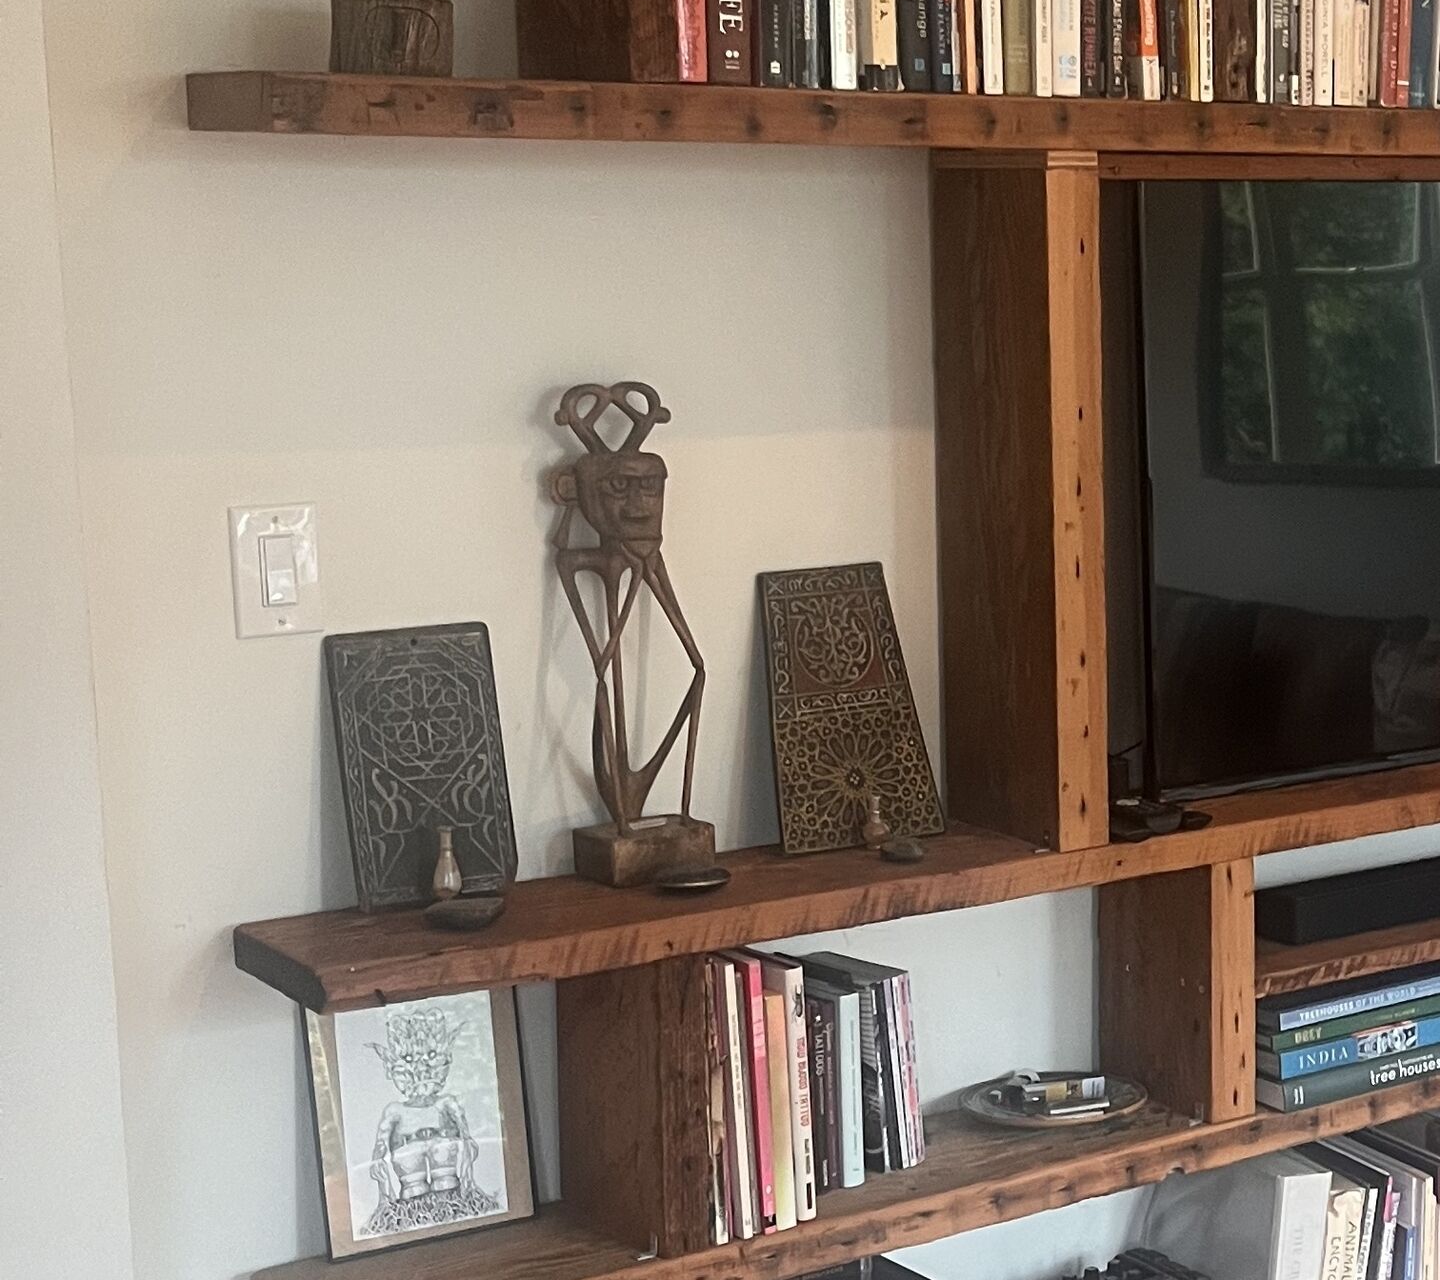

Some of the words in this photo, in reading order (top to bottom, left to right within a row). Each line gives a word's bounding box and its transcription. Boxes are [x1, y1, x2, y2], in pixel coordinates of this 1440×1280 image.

[1085, 26, 1097, 76] RUNNER
[1321, 32, 1329, 78] MORELL
[1299, 1000, 1355, 1022] TREEHOUSES
[1355, 997, 1367, 1008] OF
[1368, 993, 1386, 1005] THE
[1386, 987, 1417, 1002] WORLD
[1299, 1046, 1350, 1070] INDIA
[1370, 1067, 1397, 1086] tree
